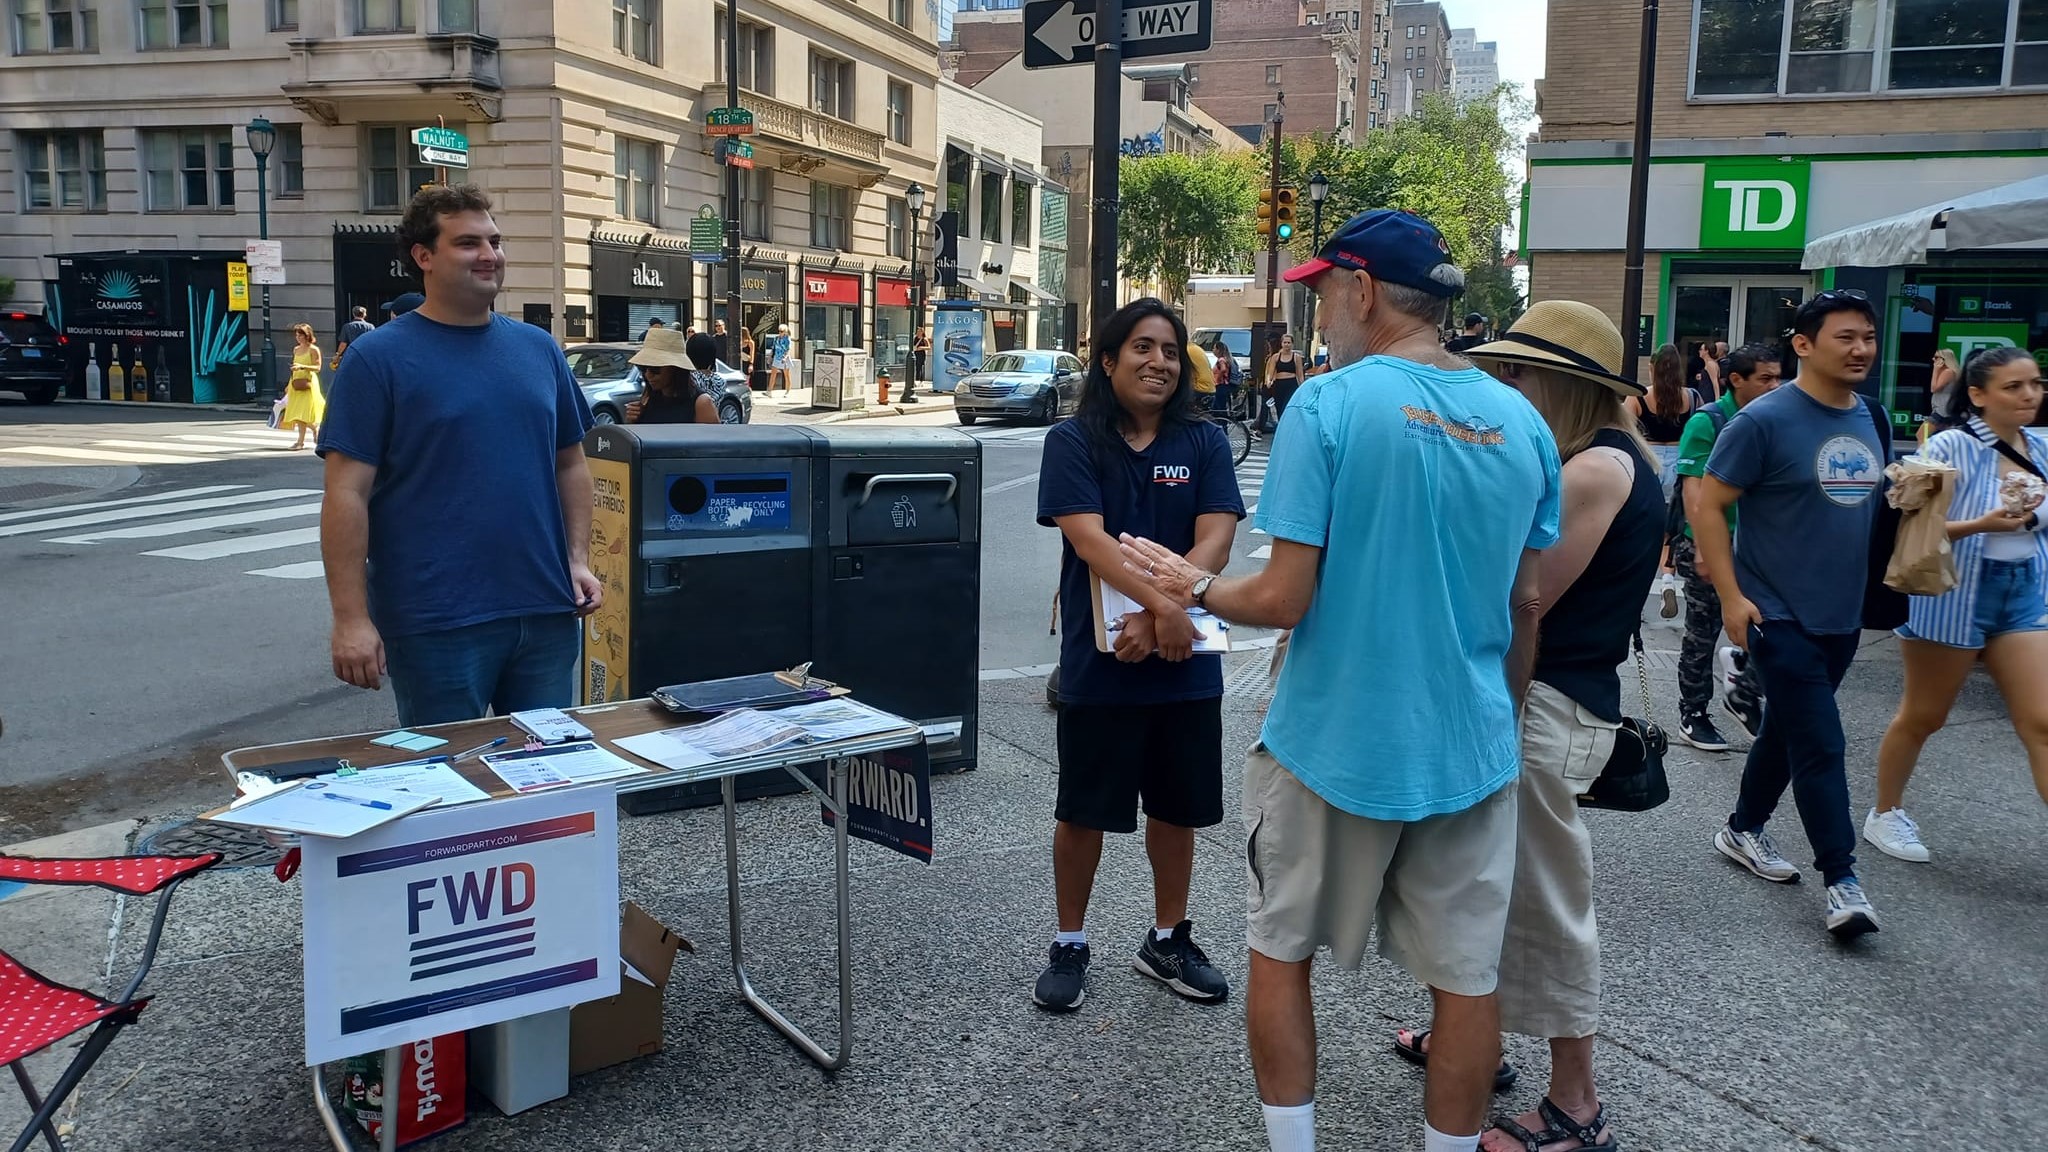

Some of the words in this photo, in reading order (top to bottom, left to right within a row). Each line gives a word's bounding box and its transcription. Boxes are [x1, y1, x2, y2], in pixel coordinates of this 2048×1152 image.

[1138, 5, 1192, 36] WAY
[742, 116, 751, 124] ST
[422, 132, 455, 148] WALNUT
[457, 141, 464, 149] ST
[432, 151, 446, 160] ONE
[448, 154, 461, 162] WAY
[1713, 180, 1797, 232] TD
[632, 262, 664, 287] aka.
[741, 278, 765, 290] AGOS
[96, 301, 143, 310] CASAMIGOS
[1960, 299, 1978, 311] TD
[1983, 301, 2012, 310] Bank
[937, 316, 978, 325] LAGOS
[67, 327, 93, 335] BROUGHT
[94, 327, 102, 335] TO
[104, 328, 116, 336] YOU
[125, 329, 143, 337] THOSE
[145, 329, 160, 337] WHO
[160, 330, 178, 338] DRINK
[178, 330, 184, 338] IT
[1892, 413, 1909, 424] TD
[1455, 443, 1474, 453] ctive
[1153, 465, 1190, 479] FWD
[608, 480, 620, 496] OUR
[603, 495, 625, 515] FRIENDS
[710, 498, 736, 506] PAPER
[742, 500, 786, 510] RECYCLING
[707, 506, 738, 515] BOTT
[753, 508, 775, 517] ONLY
[710, 514, 717, 522] &
[718, 513, 729, 522] CA
[826, 756, 926, 828] FRWARD.
[424, 834, 518, 859] FORWARDPARTY.COM
[407, 862, 536, 935] FWD
